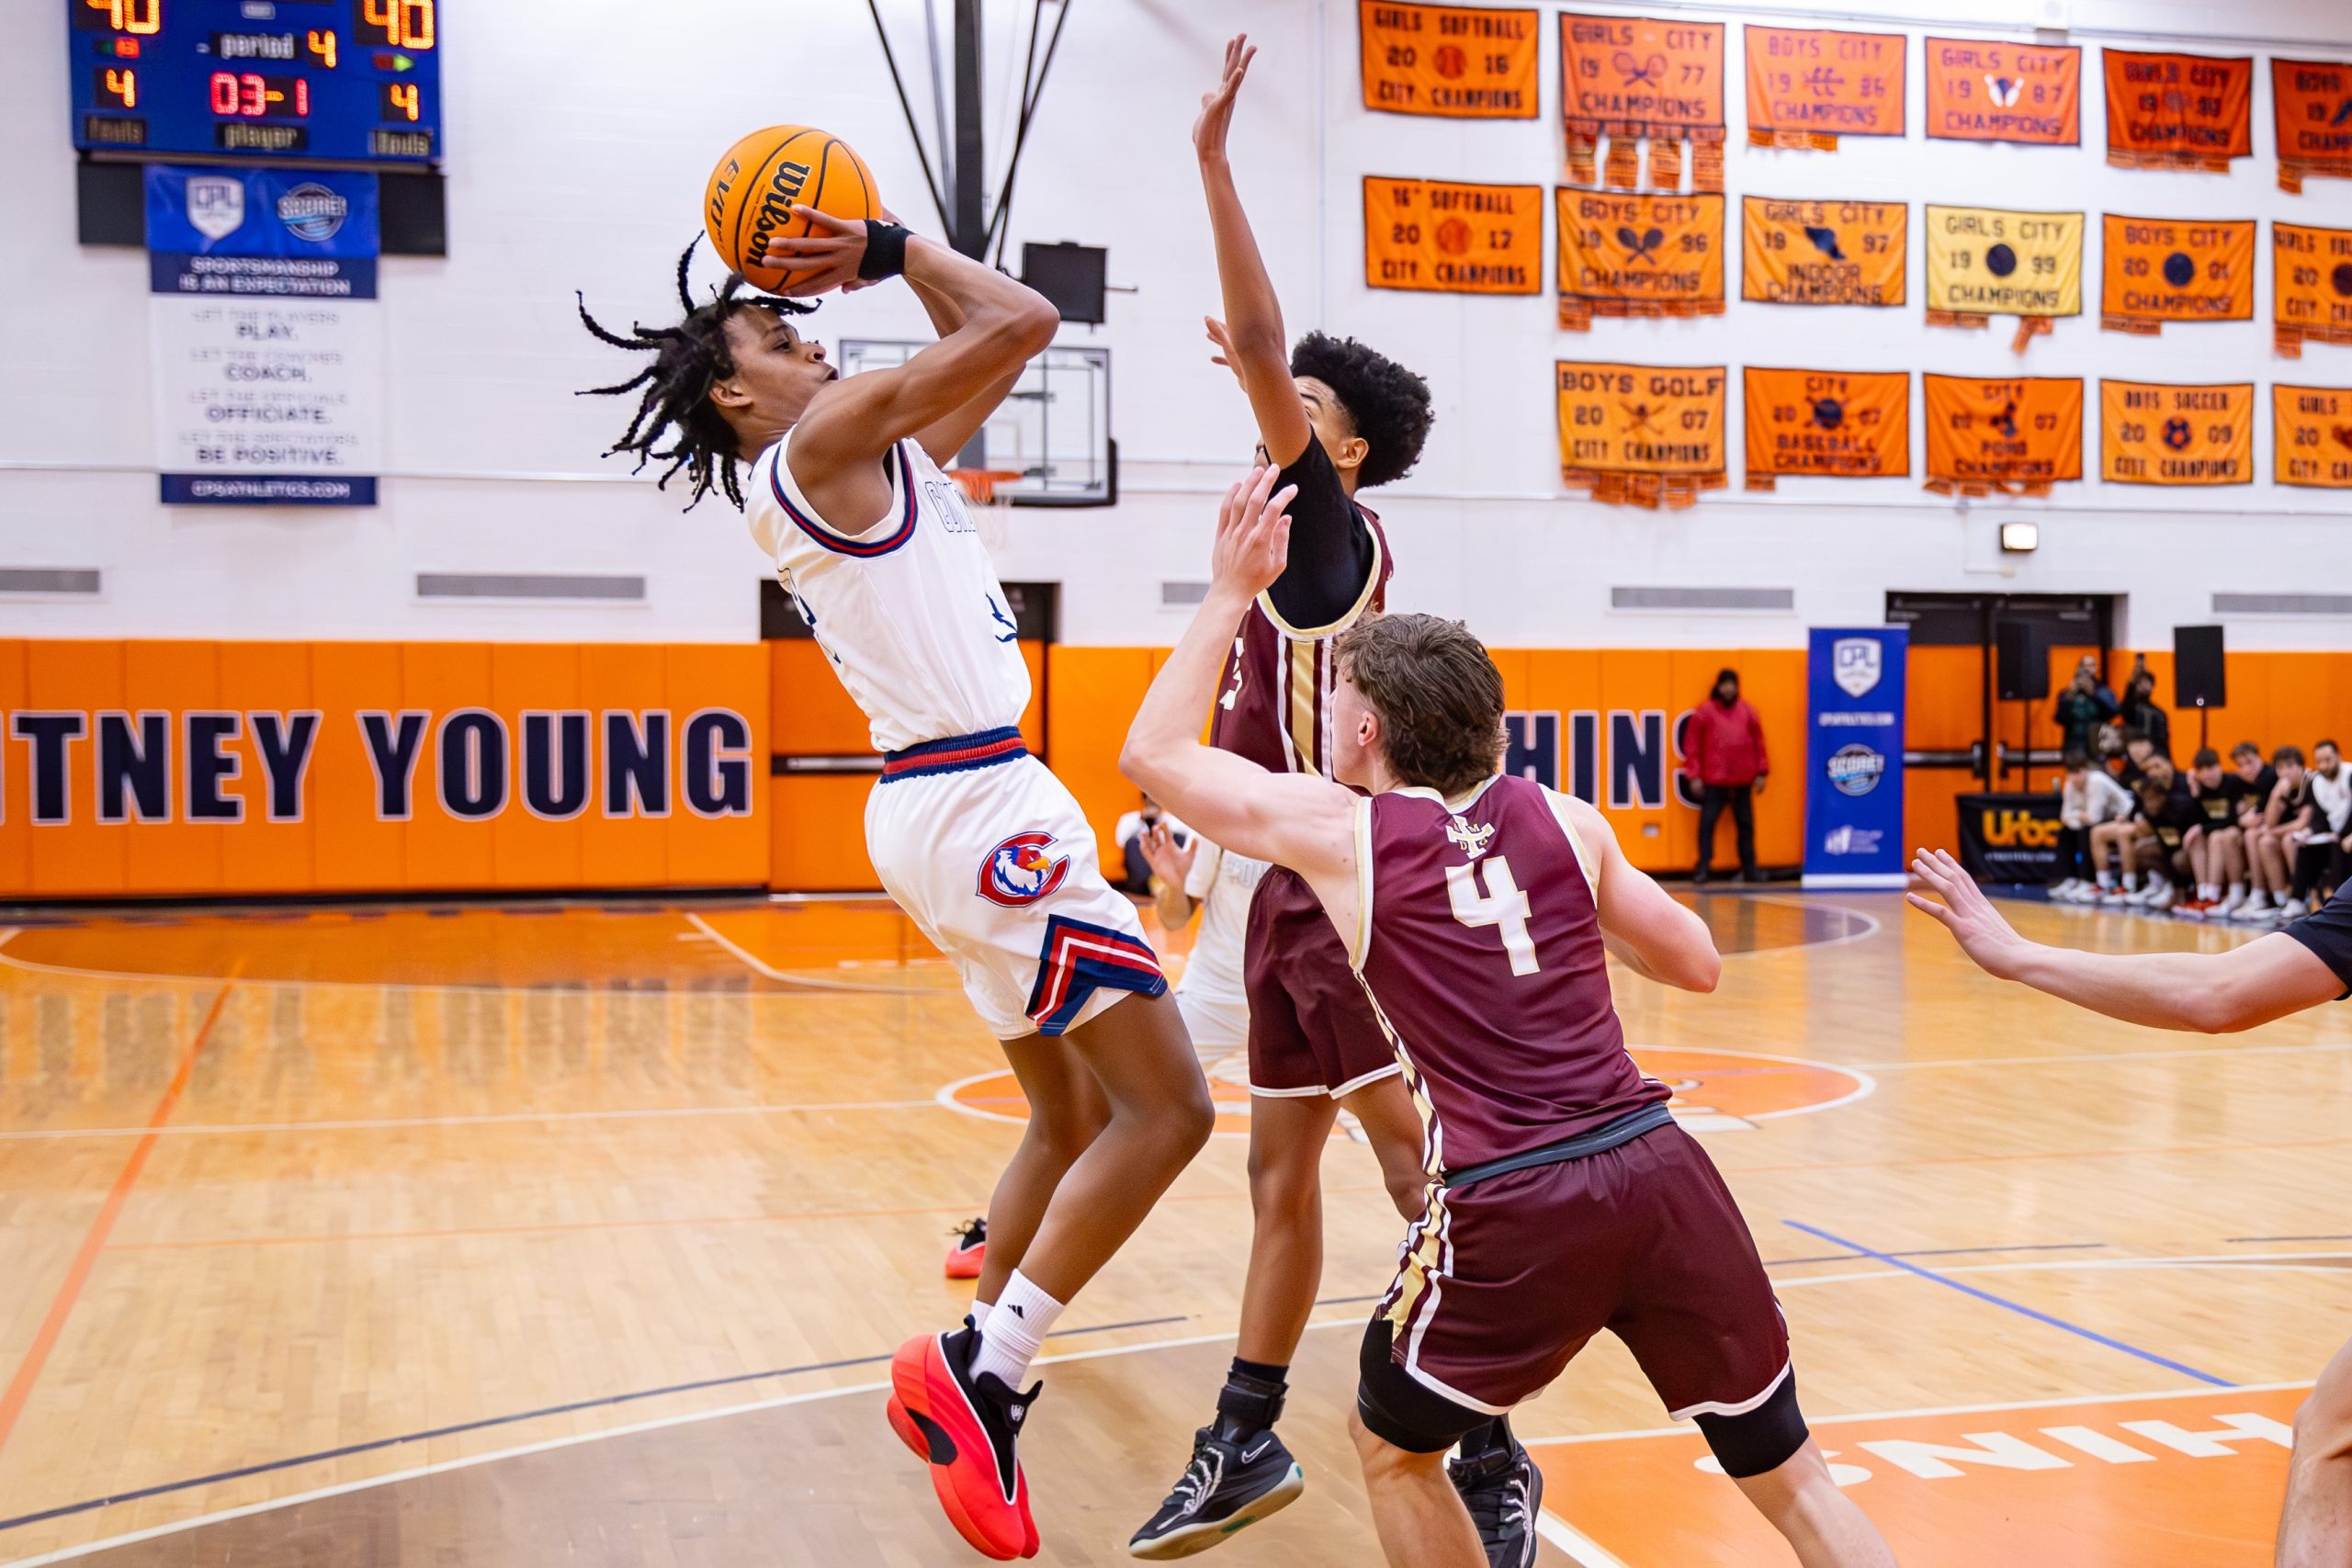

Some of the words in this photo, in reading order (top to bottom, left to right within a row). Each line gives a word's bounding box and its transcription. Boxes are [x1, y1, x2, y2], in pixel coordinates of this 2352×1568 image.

[364, 0, 435, 50] 40
[1374, 8, 1422, 32] GIRLS
[1440, 15, 1525, 40] SOFTBALL
[1573, 23, 1634, 46] GIRLS
[1667, 29, 1712, 51] CITY
[1769, 36, 1820, 58] BOYS
[1839, 39, 1882, 60] CITY
[220, 33, 295, 60] period
[308, 30, 336, 68] 4
[1386, 45, 1416, 68] 20
[1485, 54, 1509, 74] 16
[1580, 56, 1600, 78] 19
[1679, 64, 1705, 85] 77
[1942, 49, 2000, 70] GIRLS
[2018, 55, 2064, 73] CITY
[106, 69, 136, 107] 4
[1769, 73, 1791, 93] 19
[1948, 79, 1972, 97] 19
[2190, 65, 2230, 88] CITY
[390, 84, 419, 121] 4
[1380, 82, 1415, 103] CITY
[1431, 88, 1522, 109] CHAMPIONS
[1580, 92, 1706, 118] CHAMPIONS
[1774, 100, 1877, 126] CHAMPIONS
[1946, 111, 2062, 135] CHAMPIONS
[225, 122, 297, 151] player
[2130, 120, 2229, 147] CHAMPIONS
[1430, 189, 1514, 215] SOFTBALL
[1580, 198, 1637, 223] BOYS
[1653, 203, 1700, 223] CITY
[746, 161, 812, 267] Wilson
[1765, 204, 1824, 225] GIRLS
[1840, 206, 1885, 224] CITY
[1392, 224, 1420, 244] 20
[1578, 229, 1601, 250] 19
[1945, 216, 2004, 239] GIRLS
[2018, 220, 2064, 240] CITY
[2125, 225, 2175, 245] BOYS
[2189, 229, 2232, 247] CITY
[1862, 234, 1889, 254] 97
[191, 256, 339, 276] SPORTSMANSHIP
[1382, 259, 1418, 279] CITY
[1435, 263, 1526, 286] CHAMPIONS
[1787, 264, 1861, 284] INDOOR
[1951, 251, 1972, 269] 19
[2031, 256, 2056, 274] 99
[2124, 257, 2149, 276] 20
[179, 274, 199, 291] IS
[200, 275, 230, 292] AN
[231, 276, 351, 295] EXPECTATION
[1580, 266, 1701, 292] CHAMPIONS
[2294, 265, 2319, 286] 20
[1767, 281, 1883, 303] CHAMPIONS
[1948, 285, 2059, 309] CHAMPIONS
[2123, 290, 2233, 313] CHAMPIONS
[2287, 297, 2317, 316] CITY
[1562, 371, 1634, 394] BOYS
[1649, 376, 1724, 397] GOLF
[1806, 376, 1848, 392] CITY
[2175, 392, 2228, 411] SOCCER
[1574, 406, 1603, 425] 20
[1681, 411, 1710, 430] 07
[1777, 433, 1876, 453] BASEBALL
[2121, 422, 2145, 443] 20
[2209, 424, 2233, 444] 09
[2295, 425, 2320, 447] 20
[196, 446, 225, 464] BE
[1574, 439, 1608, 460] CITY
[1624, 441, 1710, 461] CHAMPIONS
[1774, 452, 1882, 472] CHAMPIONS
[1955, 458, 2054, 476] CHAMPIONS
[2161, 458, 2238, 478] CHAMPIONS
[2290, 457, 2318, 478] CITY
[191, 480, 350, 497] CPSATHLETICS.COM
[0, 709, 322, 825] TNEY
[355, 706, 753, 823] YOUNG
[1444, 854, 1542, 977] 4
